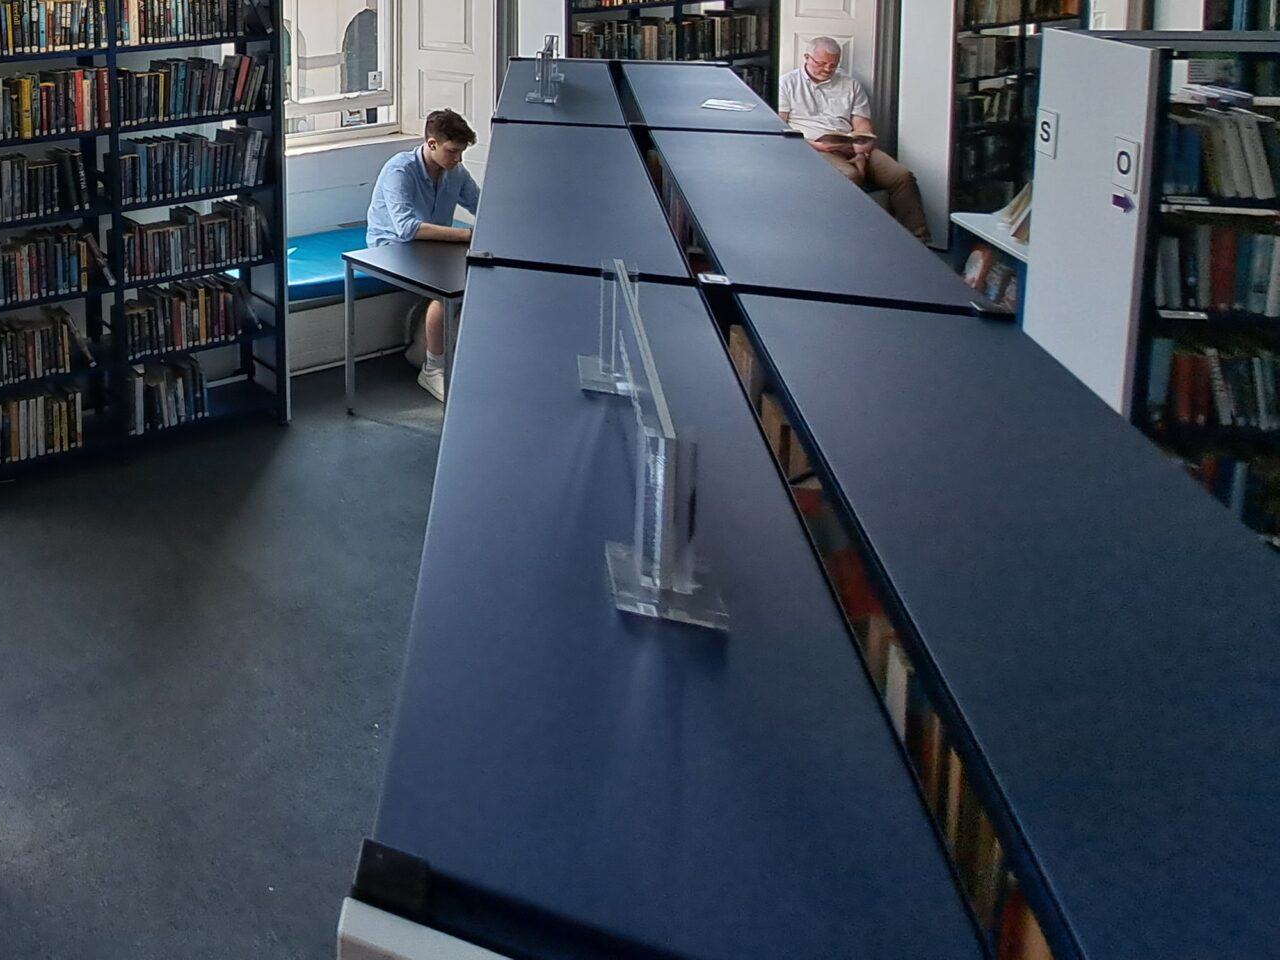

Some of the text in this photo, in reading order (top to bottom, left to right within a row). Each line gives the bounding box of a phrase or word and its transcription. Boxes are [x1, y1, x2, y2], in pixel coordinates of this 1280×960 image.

[13, 1, 21, 25] freefall
[1040, 121, 1051, 143] S
[1117, 150, 1131, 175] O
